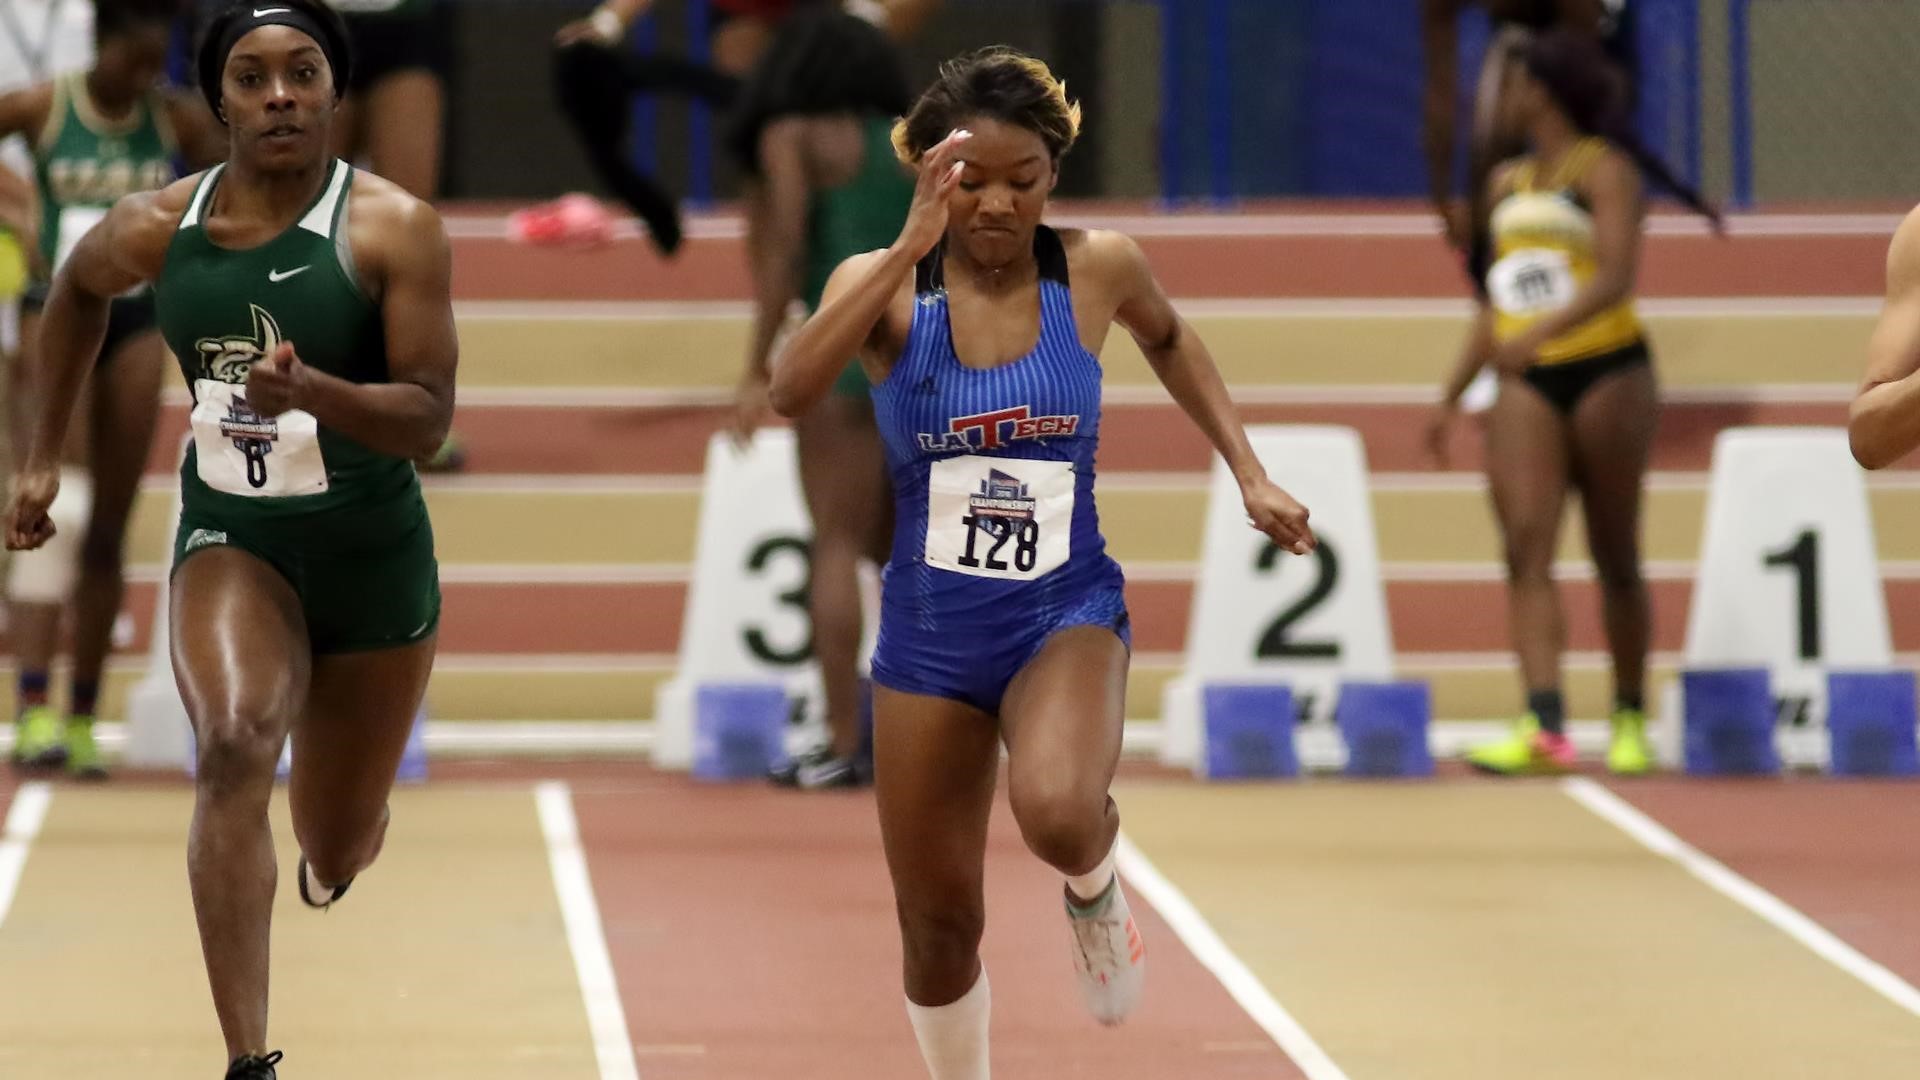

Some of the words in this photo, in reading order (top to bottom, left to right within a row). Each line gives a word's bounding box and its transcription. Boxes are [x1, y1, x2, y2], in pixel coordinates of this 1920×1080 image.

[743, 535, 813, 667] 3
[958, 515, 1039, 573] 128
[1255, 532, 1341, 660] 2
[1763, 528, 1819, 660] 1
